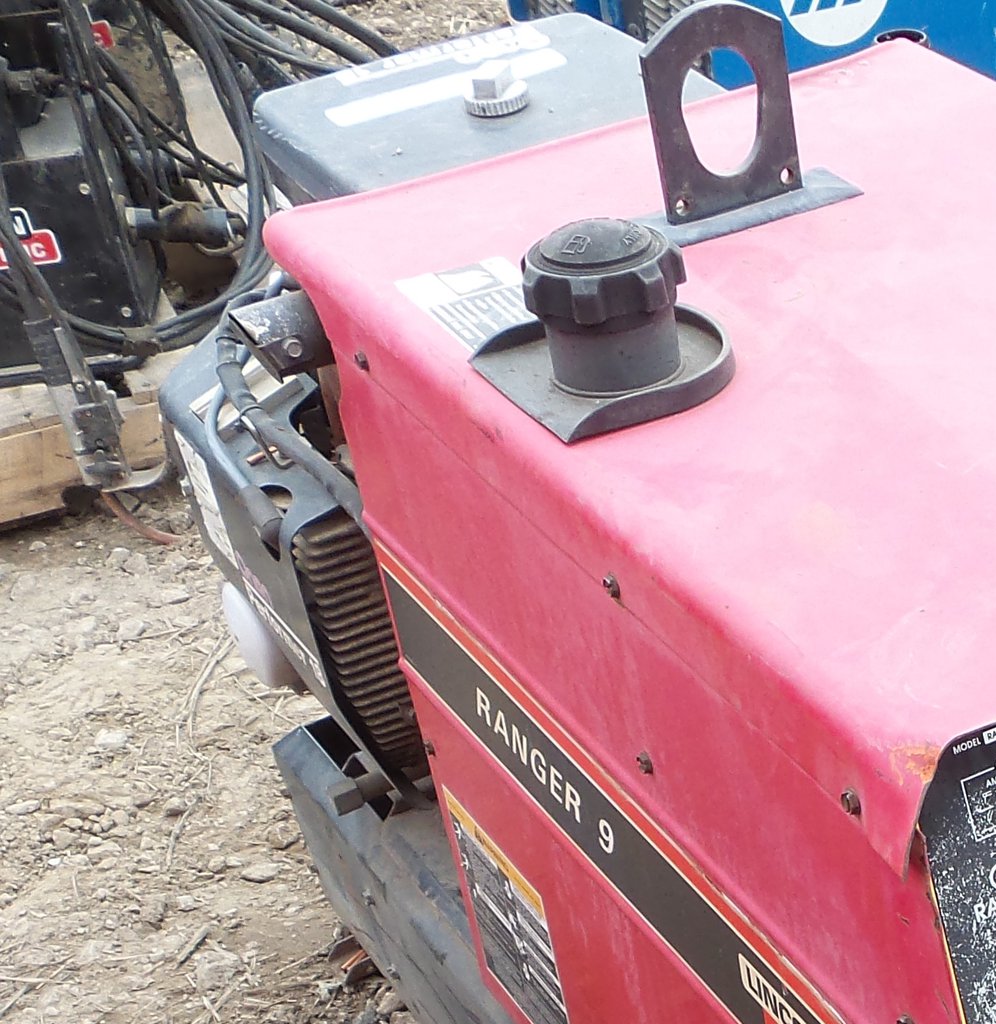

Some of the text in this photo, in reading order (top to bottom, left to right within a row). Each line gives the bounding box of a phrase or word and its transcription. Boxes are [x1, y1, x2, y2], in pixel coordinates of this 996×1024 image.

[476, 686, 581, 824] RANGER
[599, 818, 614, 854] 9
[952, 737, 982, 755] MODEL
